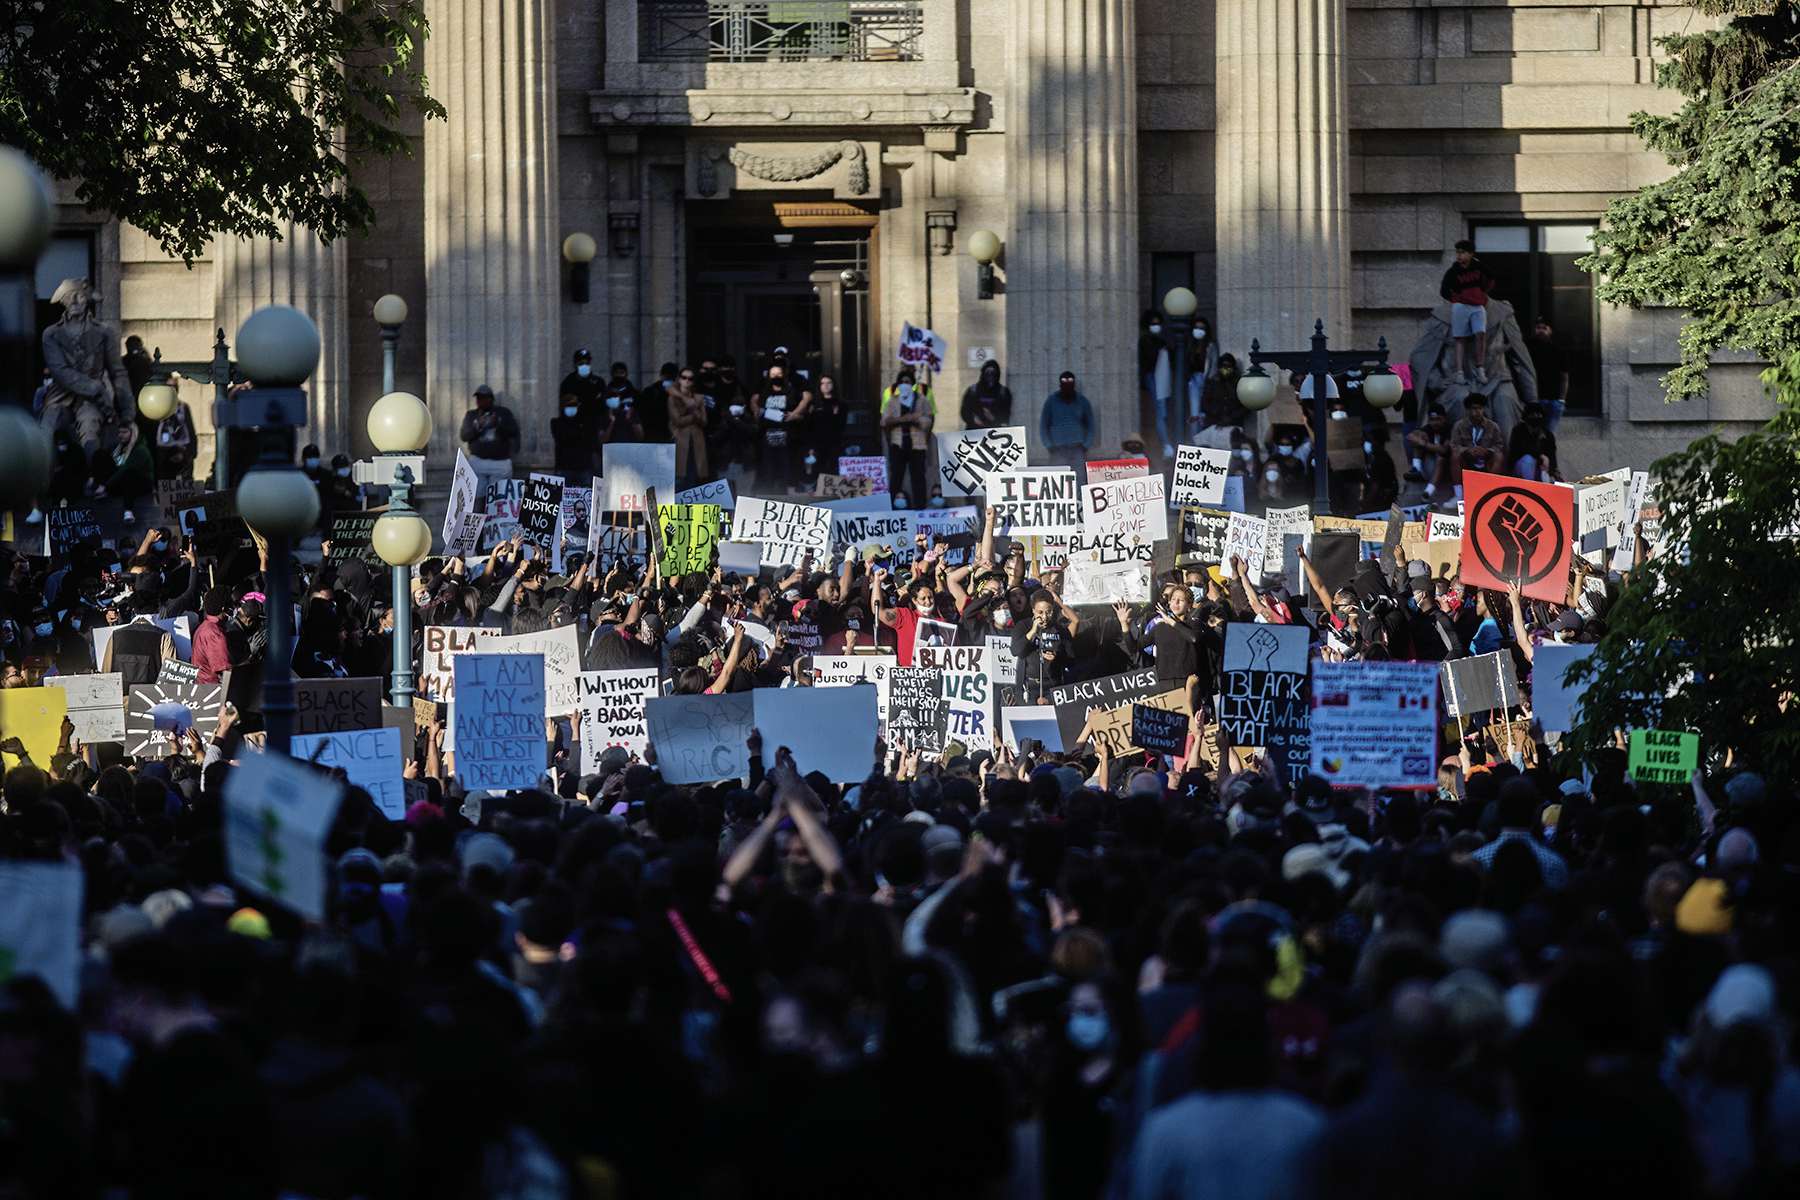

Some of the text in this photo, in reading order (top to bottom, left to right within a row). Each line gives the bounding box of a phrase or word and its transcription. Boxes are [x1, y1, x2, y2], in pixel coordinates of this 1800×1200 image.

[941, 435, 978, 482] BLACK
[952, 430, 1013, 495] LIVES
[1178, 449, 1202, 460] not
[1177, 457, 1227, 476] another
[534, 483, 550, 500] NO
[823, 477, 867, 489] BLACK
[1000, 475, 1075, 501] I CANT
[1175, 474, 1210, 490] black
[523, 498, 559, 516] JUSTICE
[1090, 484, 1133, 513] BEING
[1585, 496, 1595, 513] NO
[531, 514, 548, 528] NO
[659, 505, 682, 520] ALL
[684, 505, 693, 520] I
[763, 501, 830, 529] BLACK
[992, 503, 1076, 528] BREATHE
[1112, 508, 1123, 520] IS
[739, 519, 824, 546] LIVES
[1232, 516, 1264, 532] PROTECT
[336, 530, 354, 539] THE
[678, 524, 710, 546] DID
[1069, 533, 1125, 555] BLACK
[1232, 526, 1263, 549] BLACK
[686, 546, 703, 560] BE
[1100, 545, 1152, 564] LIVES
[669, 560, 711, 576] BLACK
[165, 660, 180, 672] THE
[832, 661, 848, 669] NO
[919, 648, 984, 673] BLACK
[465, 657, 486, 685] I
[496, 659, 534, 685] AM
[891, 668, 939, 680] REMEMBER
[583, 675, 658, 695] WITHOUT
[893, 687, 933, 697] NAMES
[1053, 671, 1157, 706] BLACK LIVES
[1229, 672, 1304, 699] BLACK
[297, 690, 368, 712] BLACK
[482, 689, 517, 715] MY
[601, 692, 644, 706] THAT
[1134, 704, 1185, 727] CALL OUT
[456, 714, 544, 738] ANCESTORS
[1134, 719, 1171, 735] RACIST
[1645, 731, 1681, 747] BLACK
[459, 739, 534, 760] WILDEST
[1646, 749, 1681, 765] LIVES
[468, 763, 537, 786] DREAMS
